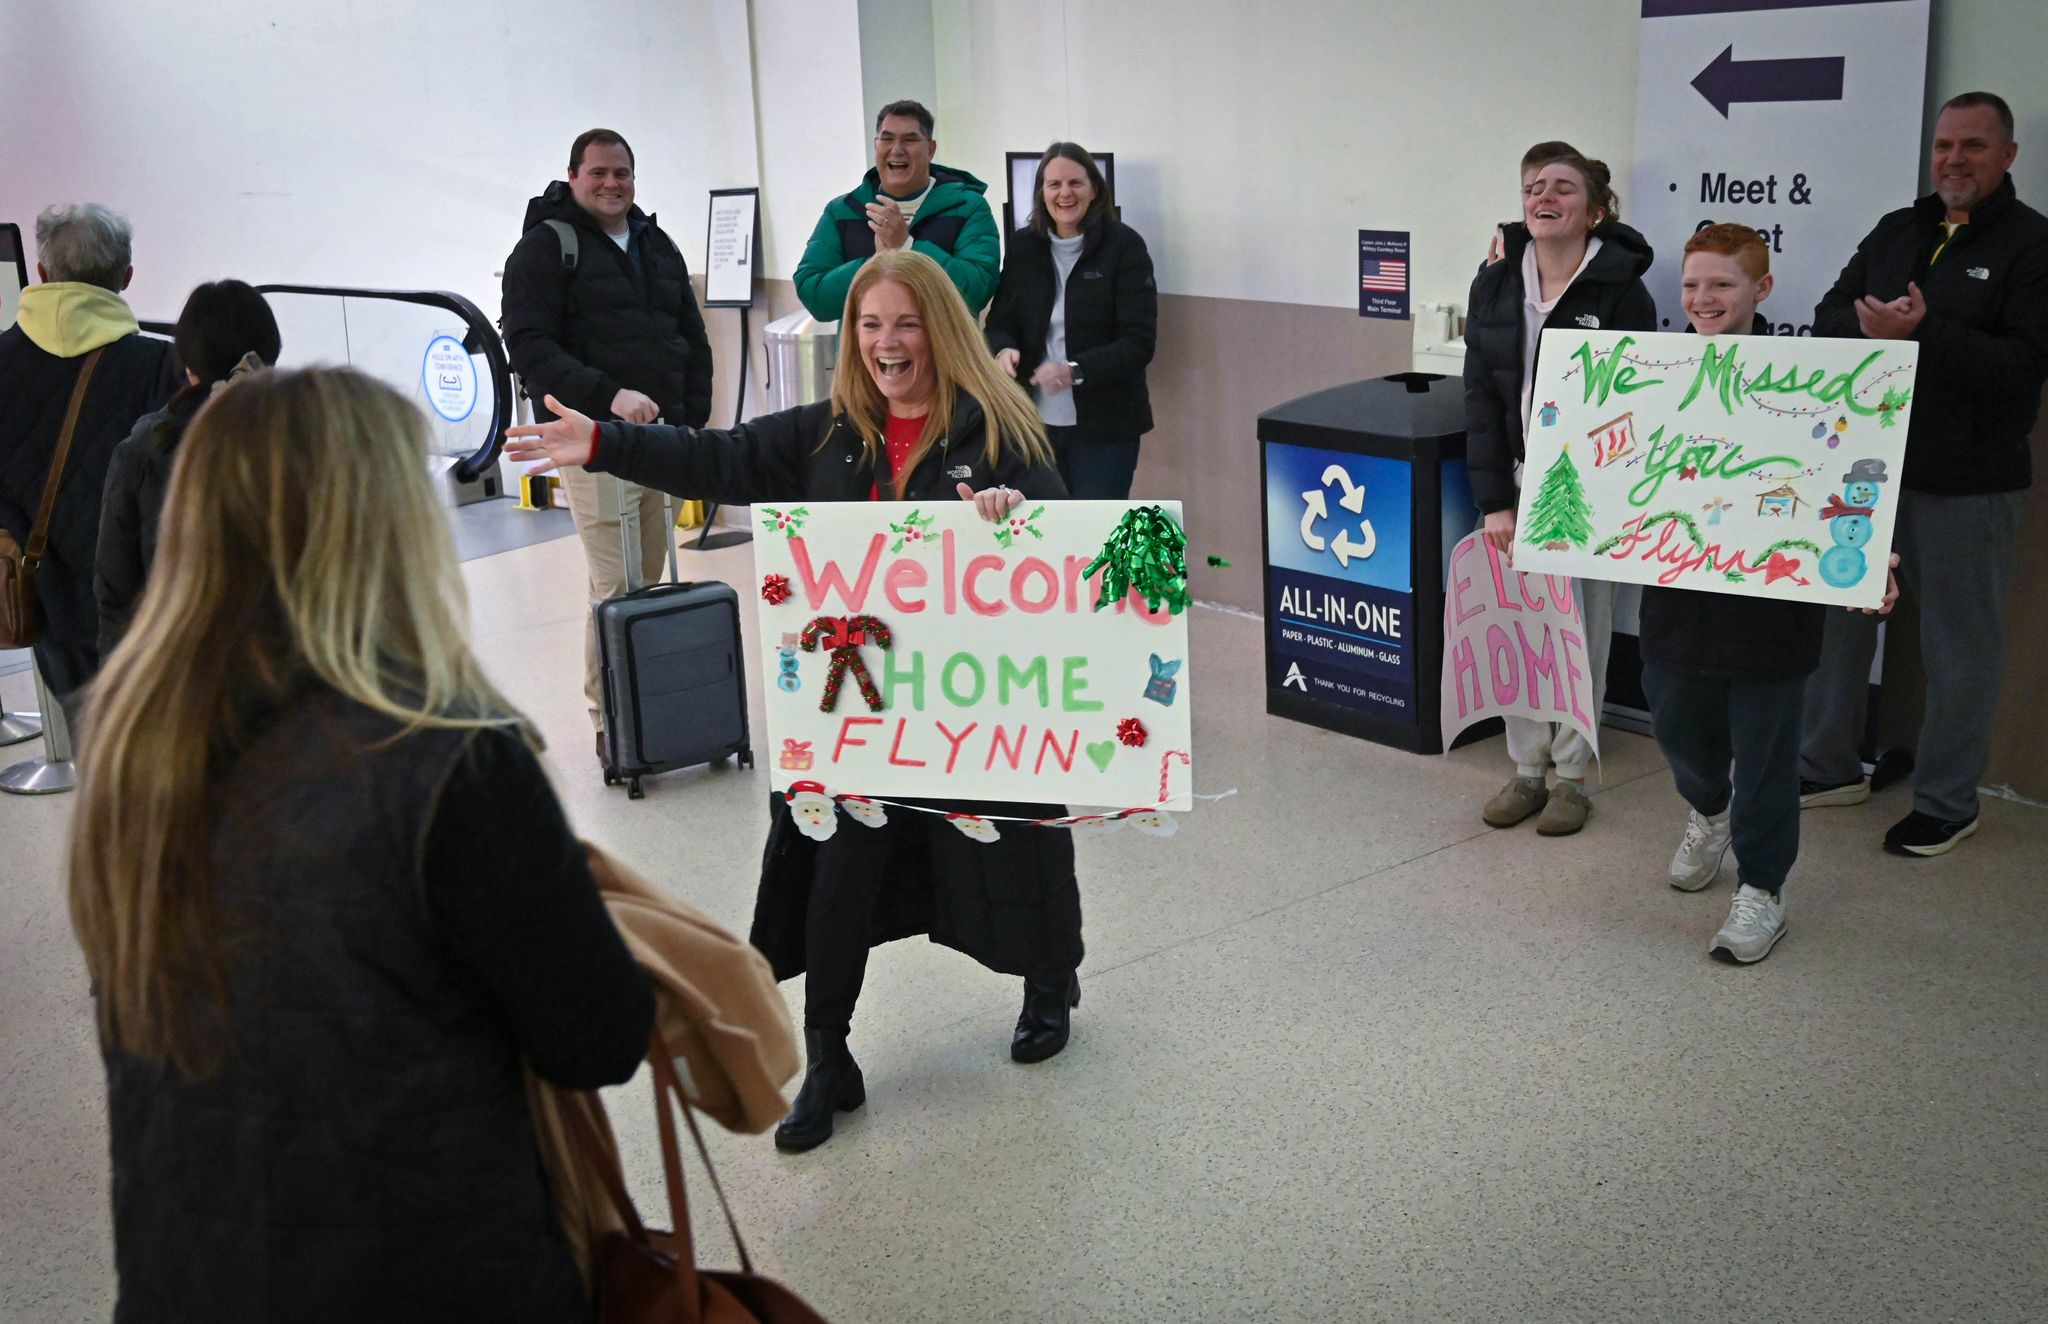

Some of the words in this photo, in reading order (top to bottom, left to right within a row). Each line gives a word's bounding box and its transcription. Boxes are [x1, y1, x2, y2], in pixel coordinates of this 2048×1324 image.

[1700, 172, 1777, 204] Meet
[1788, 173, 1812, 205] &
[1380, 306, 1402, 314] Terminal
[1571, 335, 1664, 408] We
[1678, 342, 1885, 417] Missed
[1627, 424, 1802, 507] You
[1609, 512, 1768, 585] Flynn
[1280, 585, 1401, 638] ALL-IN-ONE
[1282, 629, 1302, 643] PAPER
[1307, 634, 1333, 649] PLASTIC
[1338, 642, 1374, 658] ALUMINUM
[1379, 651, 1401, 665] GLASS
[1452, 619, 1592, 732] HOME
[883, 649, 1105, 712] HOME
[1314, 677, 1335, 689] THANK
[1336, 683, 1351, 693] YOU
[1353, 688, 1367, 697] FOR
[1368, 692, 1405, 707] RECYCLING
[832, 716, 1080, 775] FLYNN
